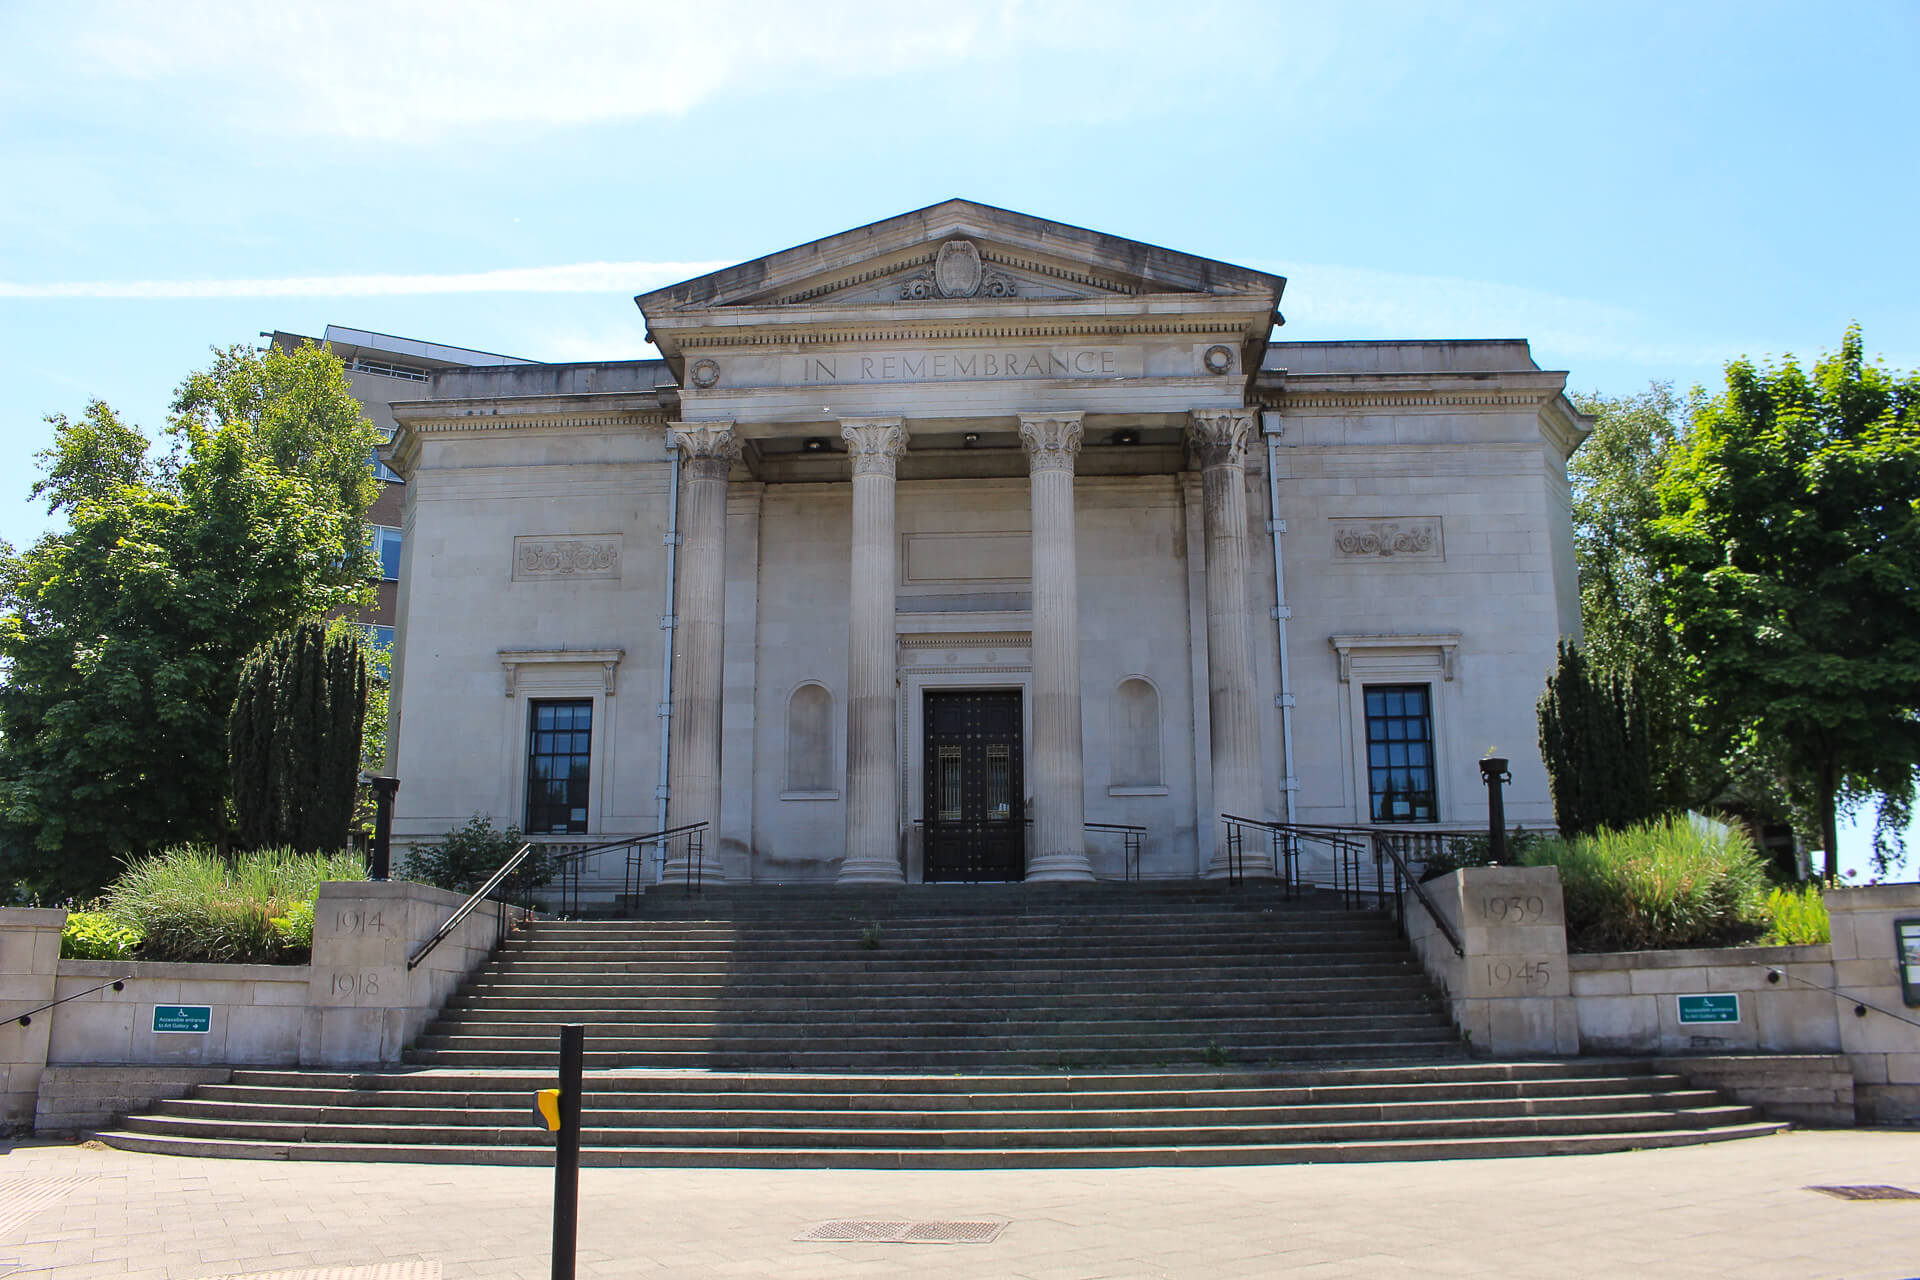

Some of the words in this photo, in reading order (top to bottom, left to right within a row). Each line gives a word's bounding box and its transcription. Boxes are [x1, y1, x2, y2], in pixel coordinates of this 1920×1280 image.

[804, 358, 837, 381] IN
[860, 351, 1115, 379] REMEMBRANCE
[335, 911, 385, 934] 1914
[1482, 895, 1544, 923] 1939
[331, 972, 379, 999] 1918
[1487, 960, 1550, 989] 1945
